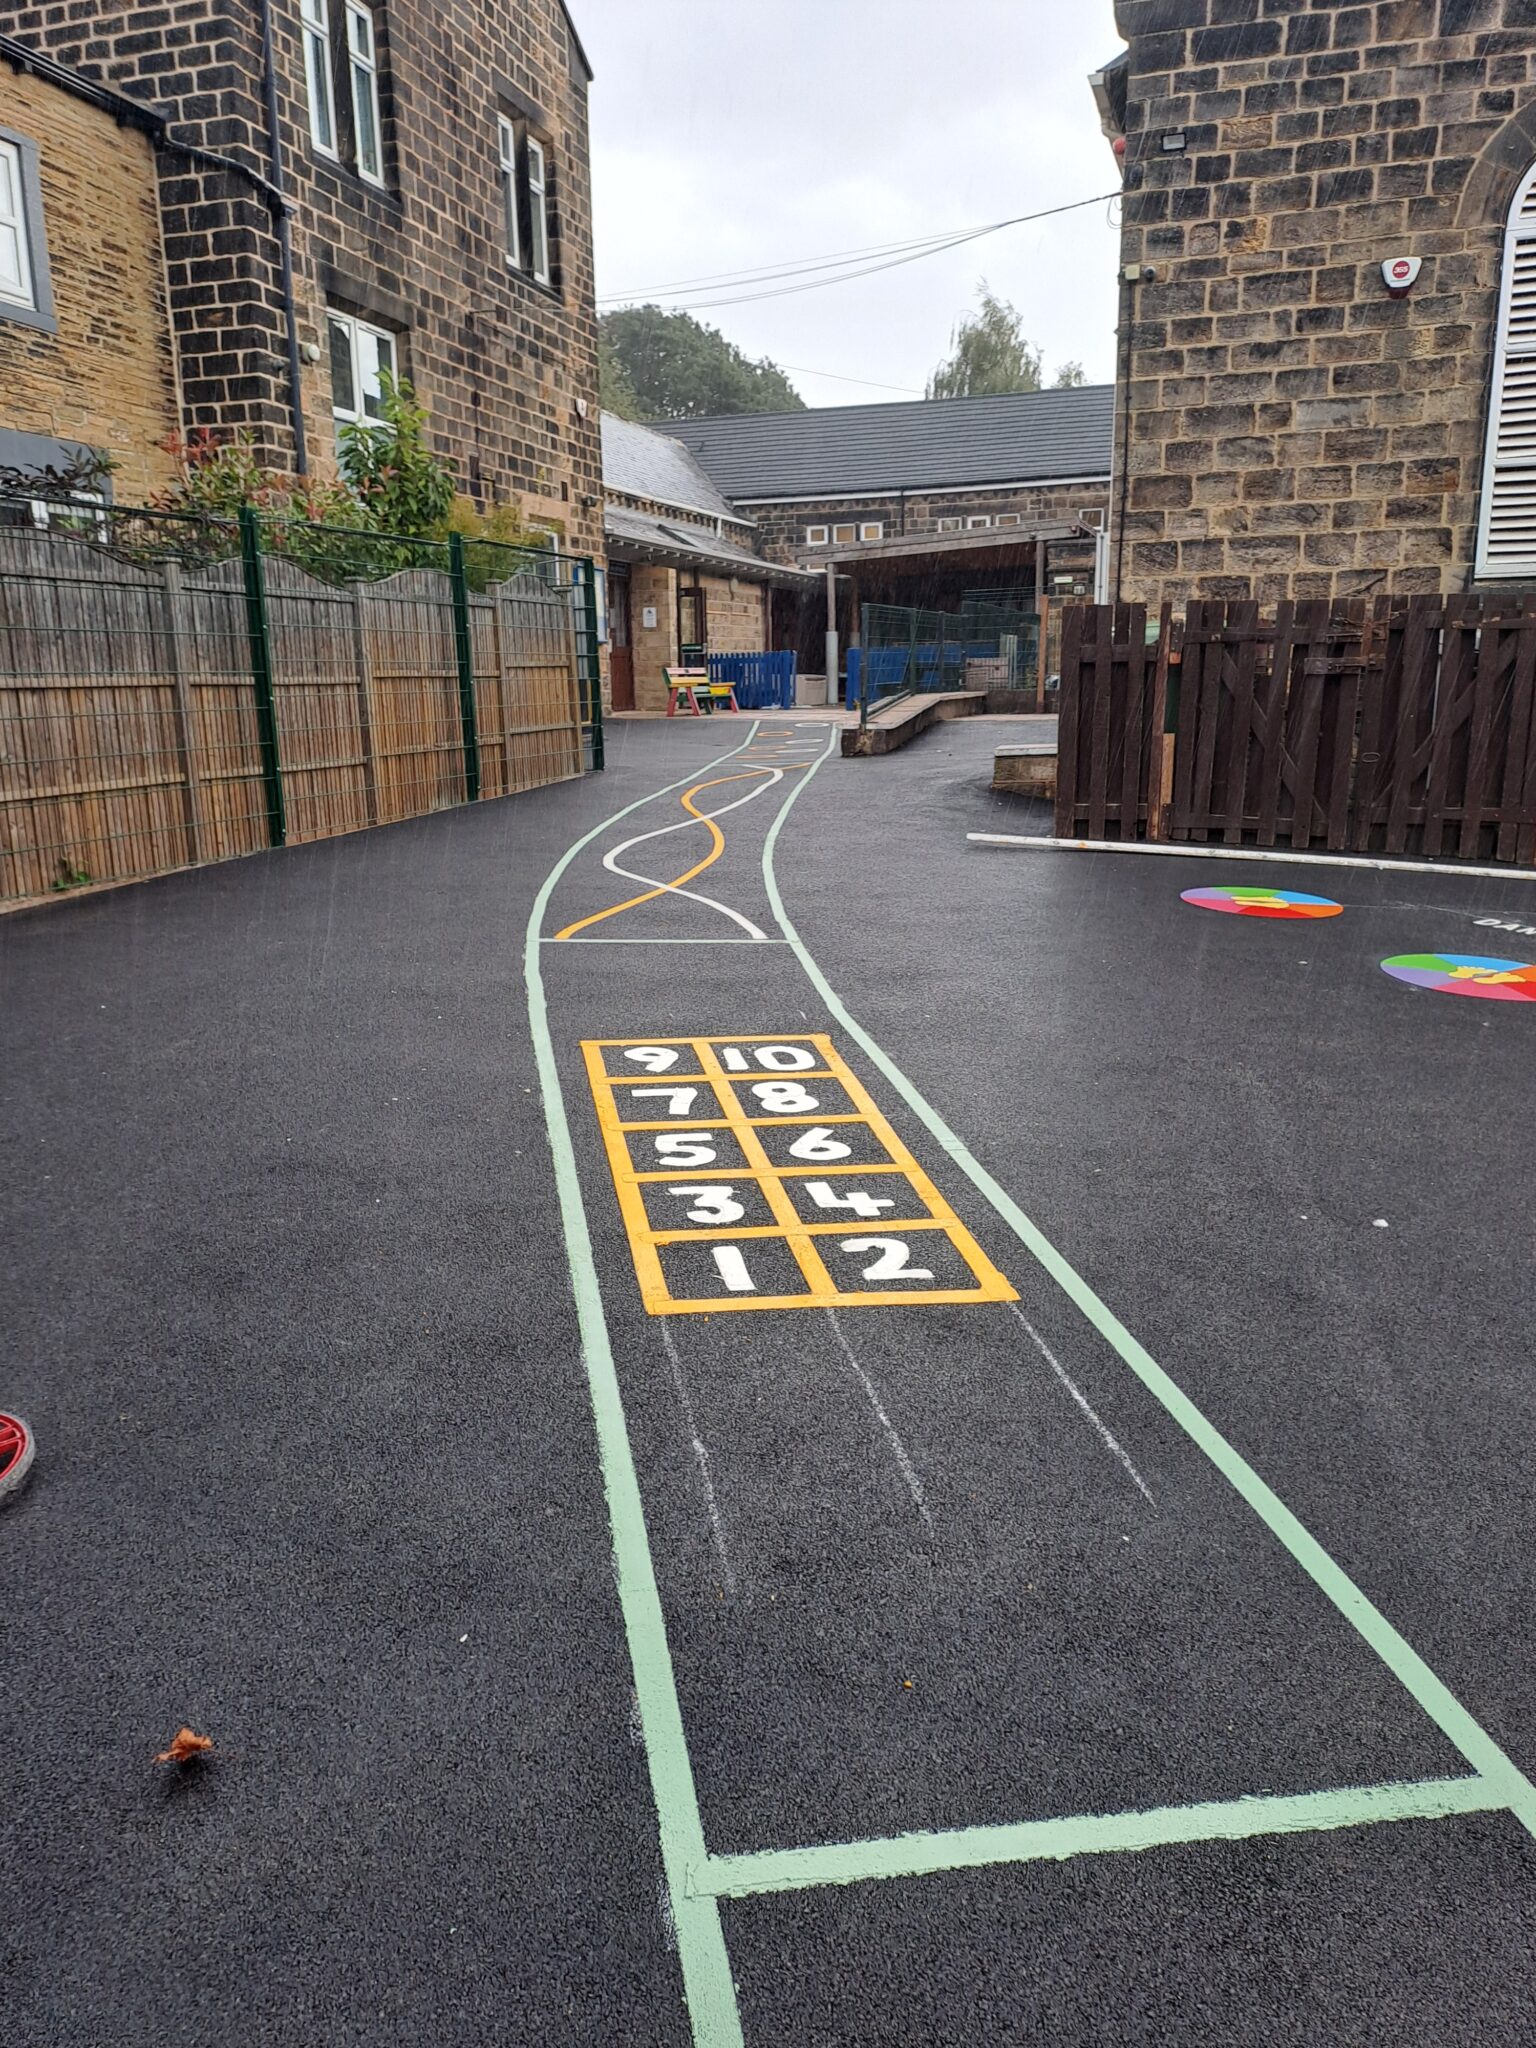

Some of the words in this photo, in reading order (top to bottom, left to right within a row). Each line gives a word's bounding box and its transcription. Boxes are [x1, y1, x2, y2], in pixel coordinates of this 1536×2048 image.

[623, 1046, 679, 1073] 9
[722, 1045, 816, 1071] 10
[631, 1086, 698, 1115] 7
[751, 1081, 820, 1113] 8
[654, 1132, 717, 1167] 5
[788, 1126, 852, 1161] 6
[667, 1185, 745, 1225] 3
[803, 1181, 895, 1217] 4
[711, 1245, 757, 1292] 1
[840, 1237, 935, 1281] 2
